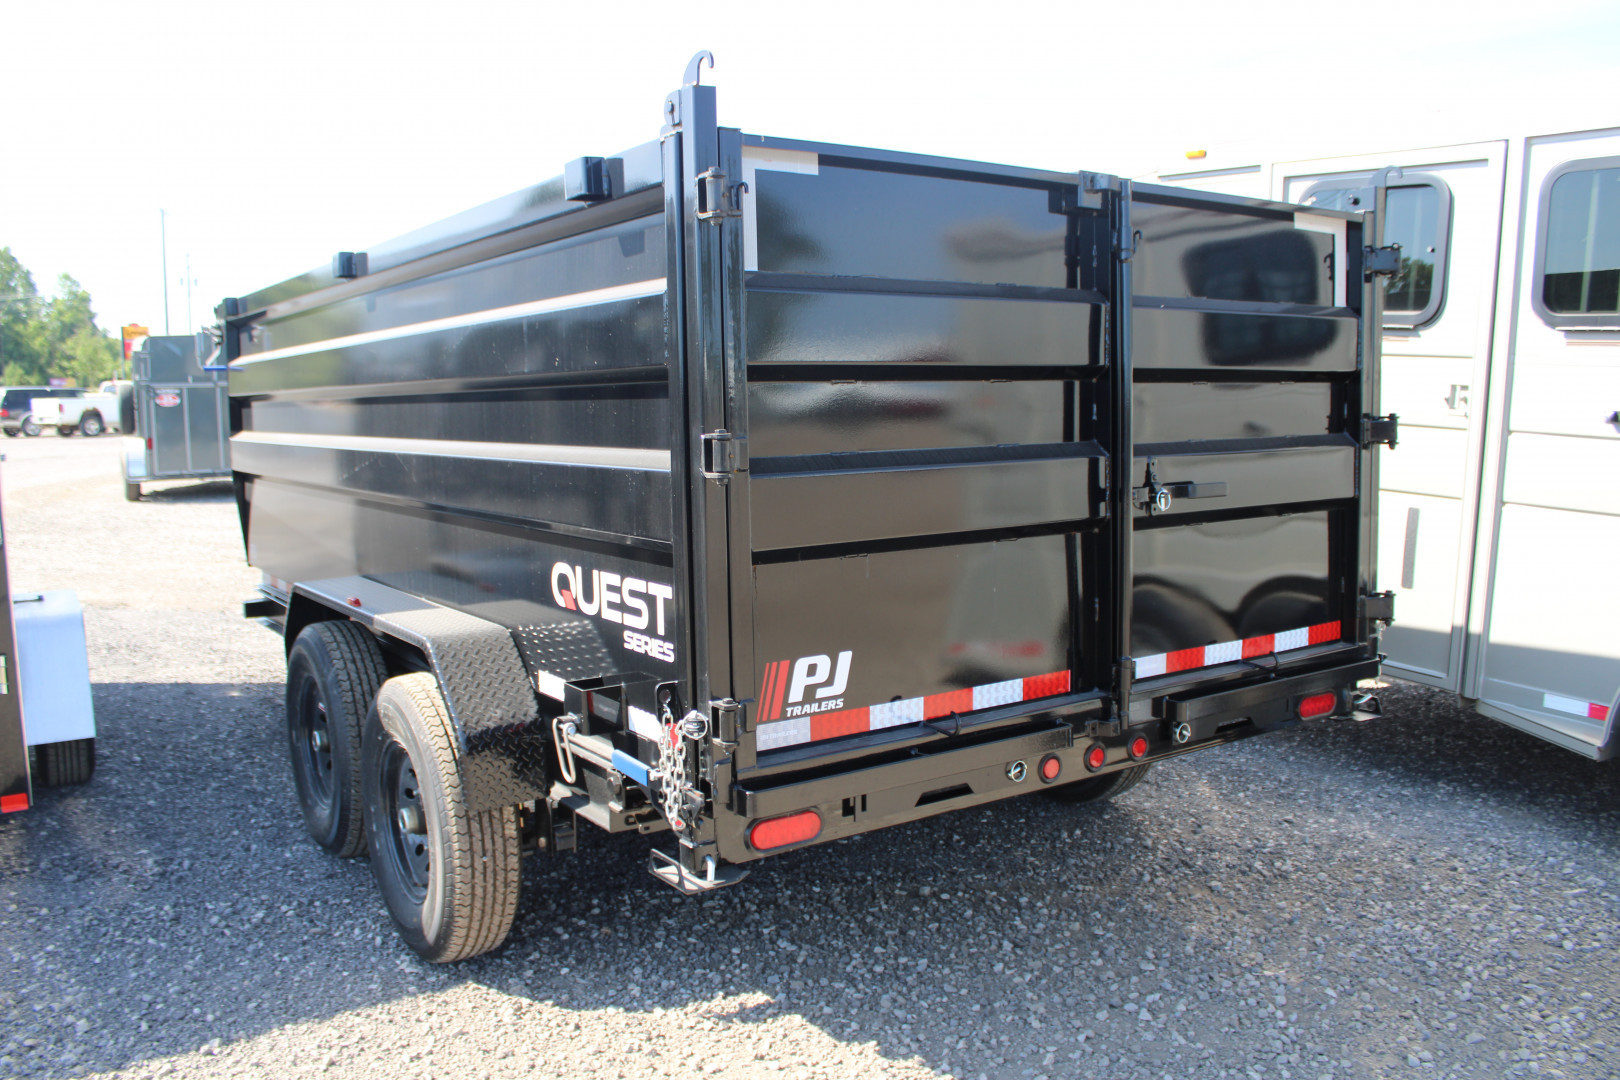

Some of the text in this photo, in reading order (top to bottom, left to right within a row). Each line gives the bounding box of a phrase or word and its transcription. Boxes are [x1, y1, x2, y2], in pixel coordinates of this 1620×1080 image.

[551, 561, 673, 636] QUEST
[623, 629, 675, 663] SERIES
[788, 650, 853, 704] PJ
[786, 698, 844, 717] TRAILERS
